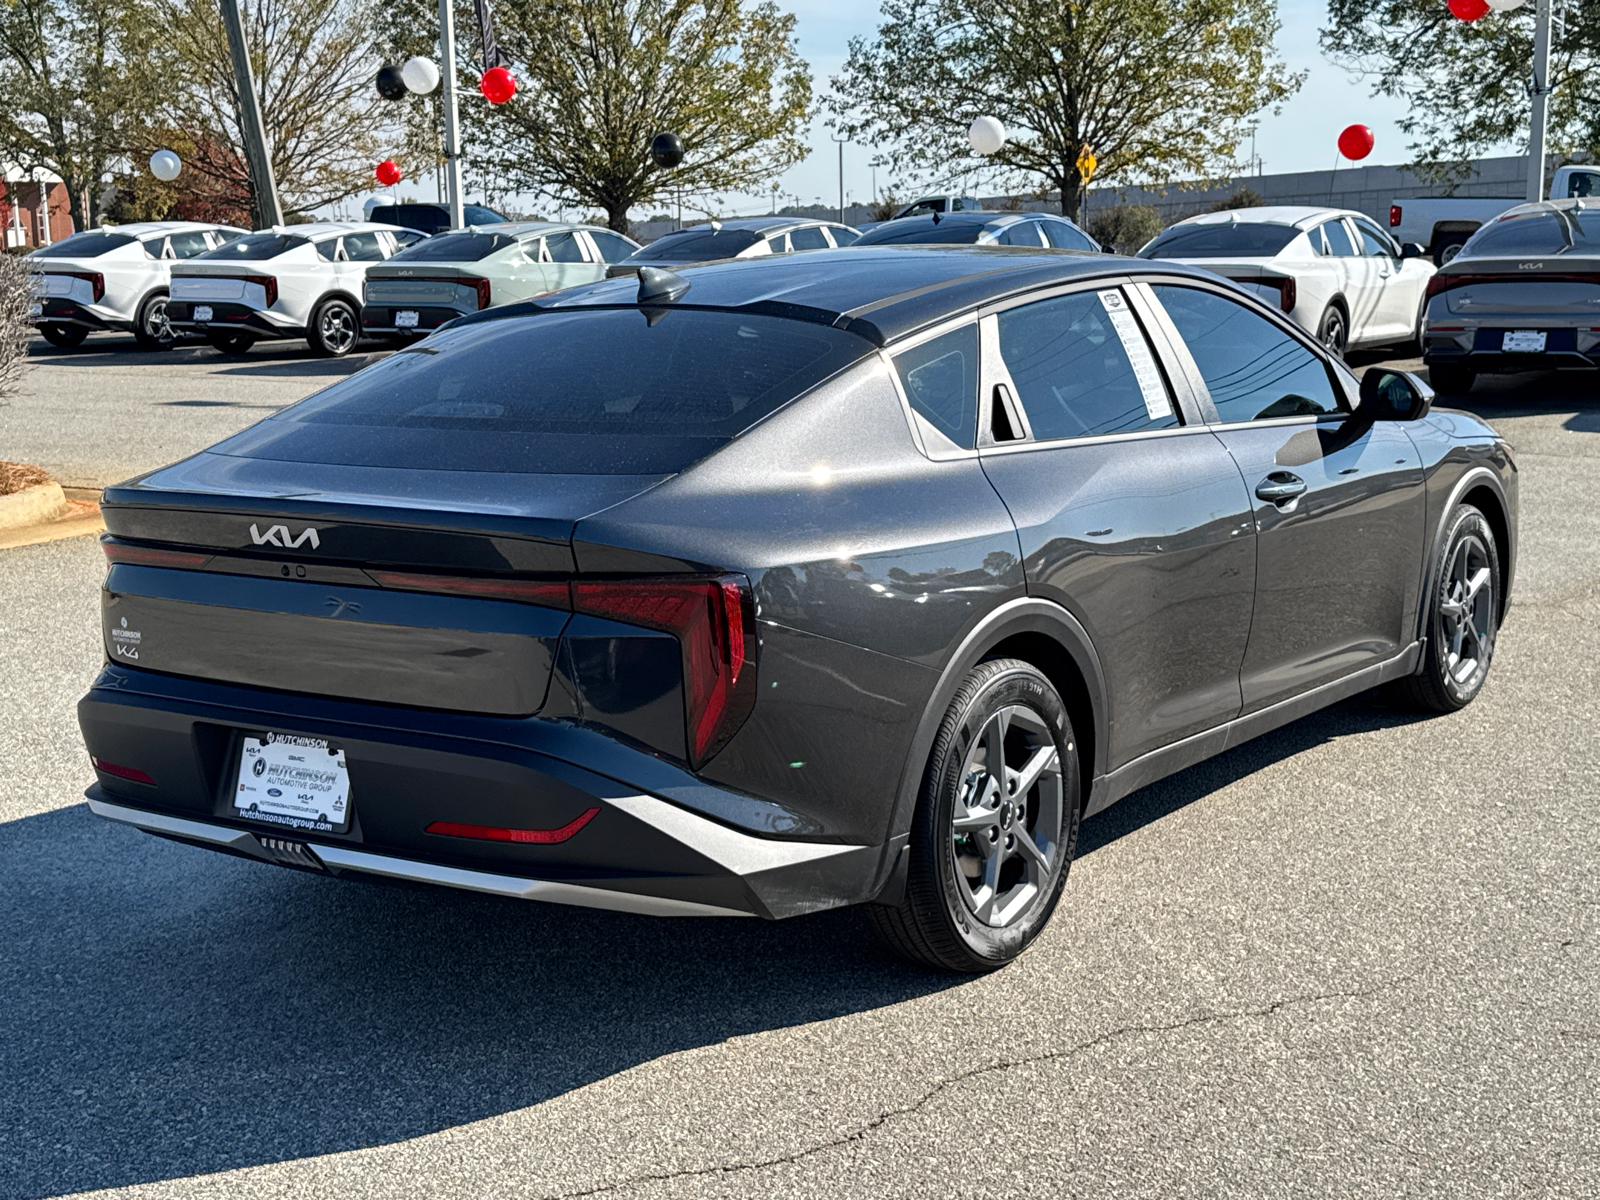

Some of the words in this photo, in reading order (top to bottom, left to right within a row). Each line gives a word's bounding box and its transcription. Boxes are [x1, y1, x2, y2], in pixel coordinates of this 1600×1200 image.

[249, 523, 321, 550] KIA
[116, 644, 139, 660] K4
[275, 734, 329, 750] HUTCHINSON
[266, 776, 308, 790] AUTOMOTIVE
[309, 782, 333, 793] GROUP
[267, 763, 338, 785] HUTCHINSON
[239, 809, 333, 832] Hutchinsonautogroup.com
[1057, 808, 1080, 893] KUMHO
